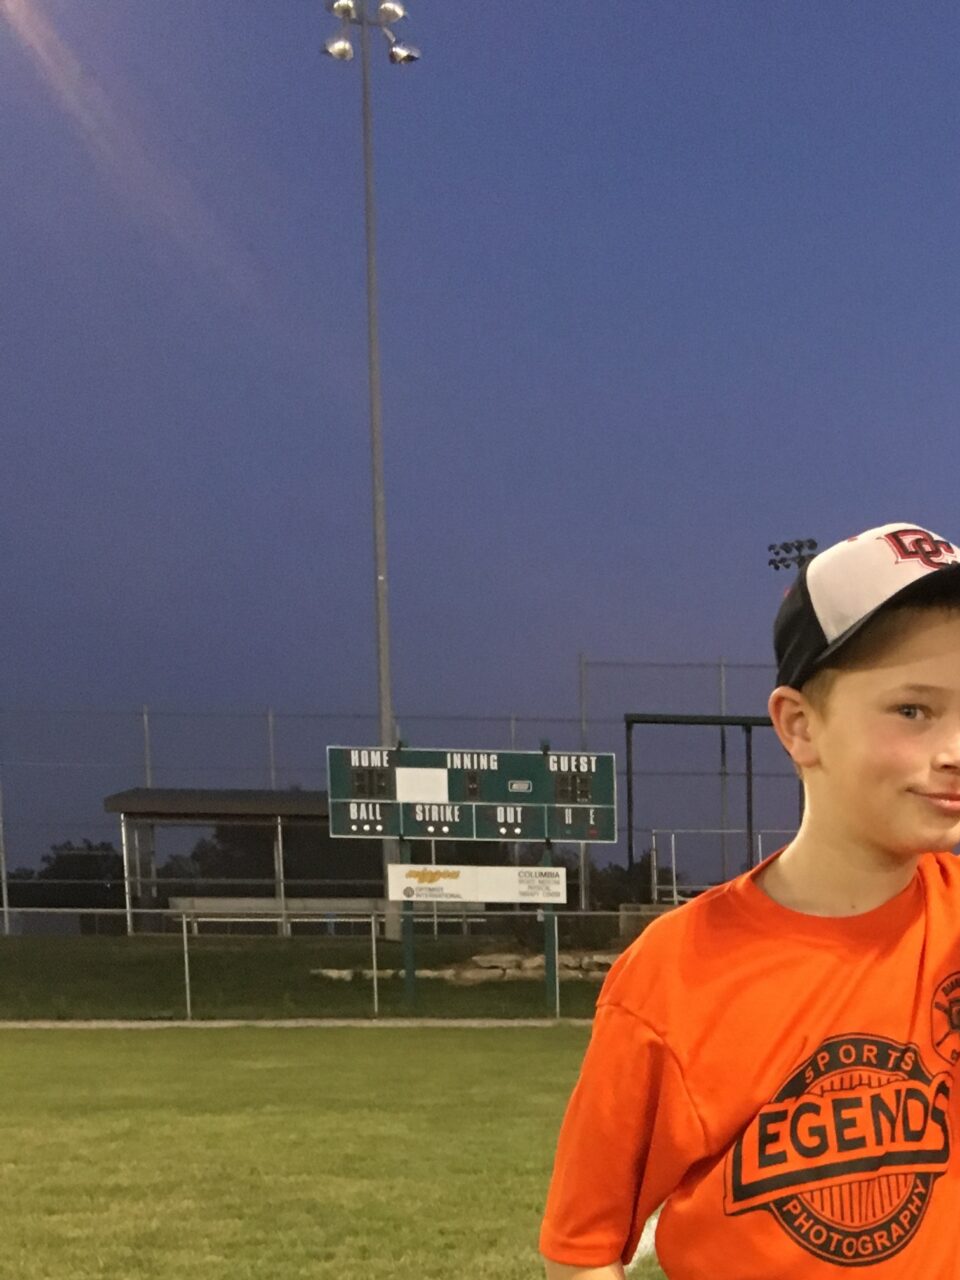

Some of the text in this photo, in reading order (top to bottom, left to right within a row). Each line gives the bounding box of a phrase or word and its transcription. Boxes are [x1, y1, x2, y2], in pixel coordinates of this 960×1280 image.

[350, 749, 390, 768] HOME
[446, 752, 499, 770] INNING
[549, 755, 598, 773] GUEST
[349, 803, 382, 820] BALL
[415, 804, 460, 822] STRIKE
[496, 806, 522, 823] OUT
[518, 870, 560, 879] COLUMBIA
[804, 1043, 917, 1084] SPORTS
[782, 1179, 928, 1257] PHOTOGRAPHY
